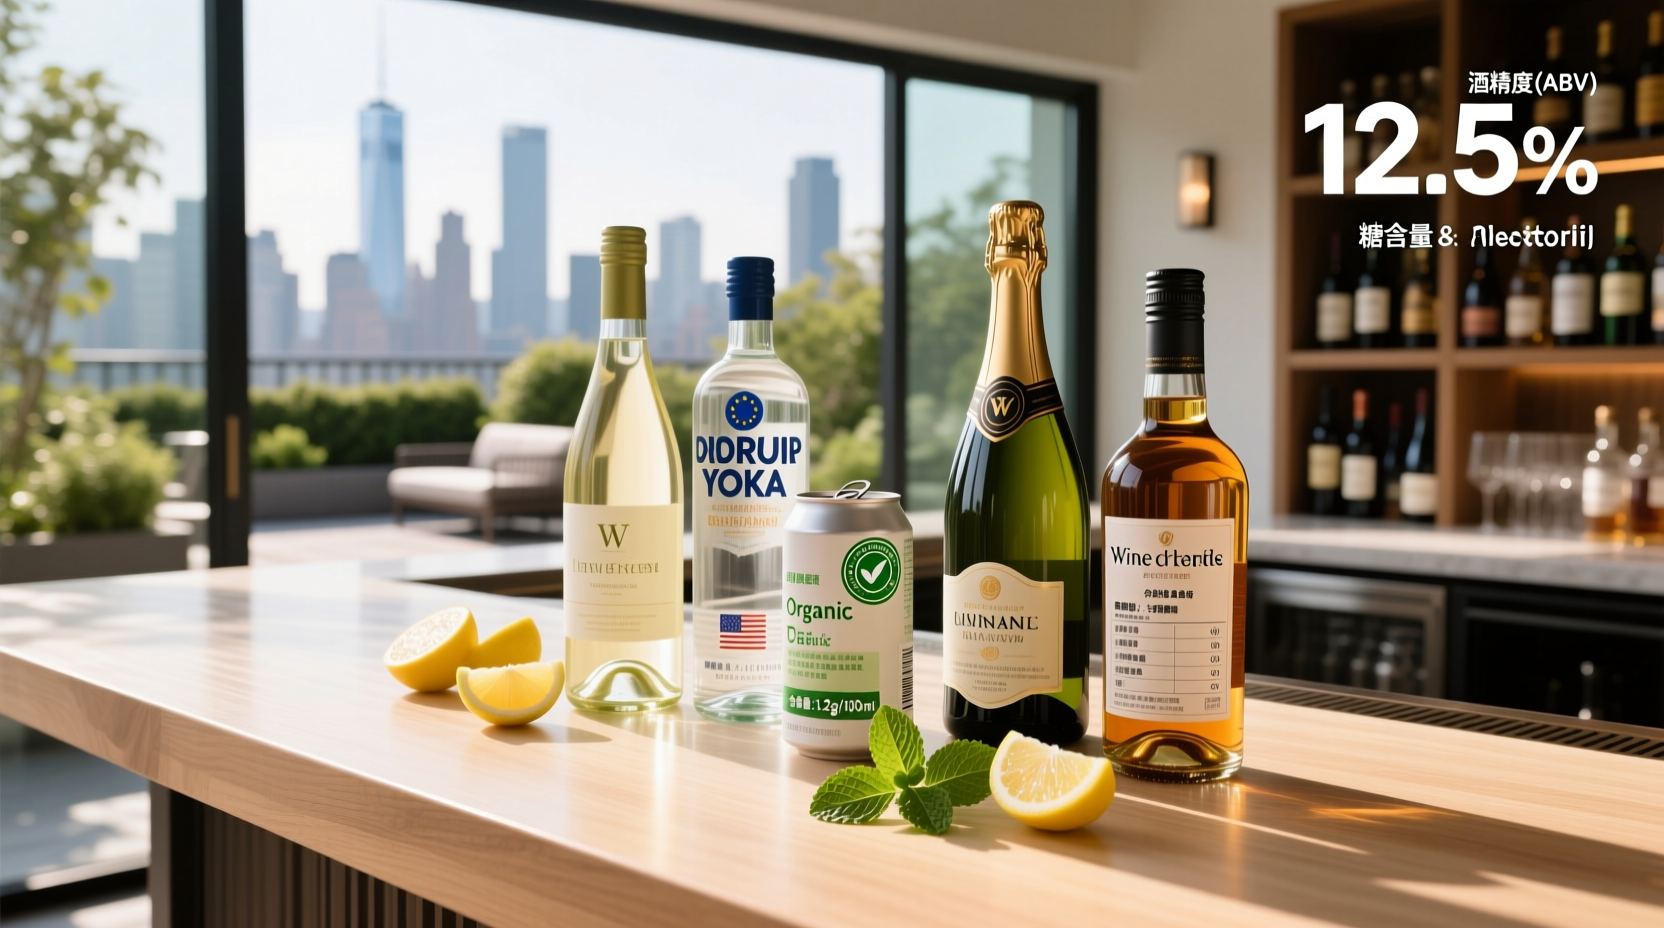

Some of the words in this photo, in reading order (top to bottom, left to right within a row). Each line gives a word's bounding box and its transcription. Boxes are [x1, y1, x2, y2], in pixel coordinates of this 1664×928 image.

[990, 396, 1015, 417] W
[702, 468, 787, 498] YOKA
[597, 523, 630, 549] W
[1110, 546, 1152, 567] Wine
[786, 597, 853, 624] Organic
